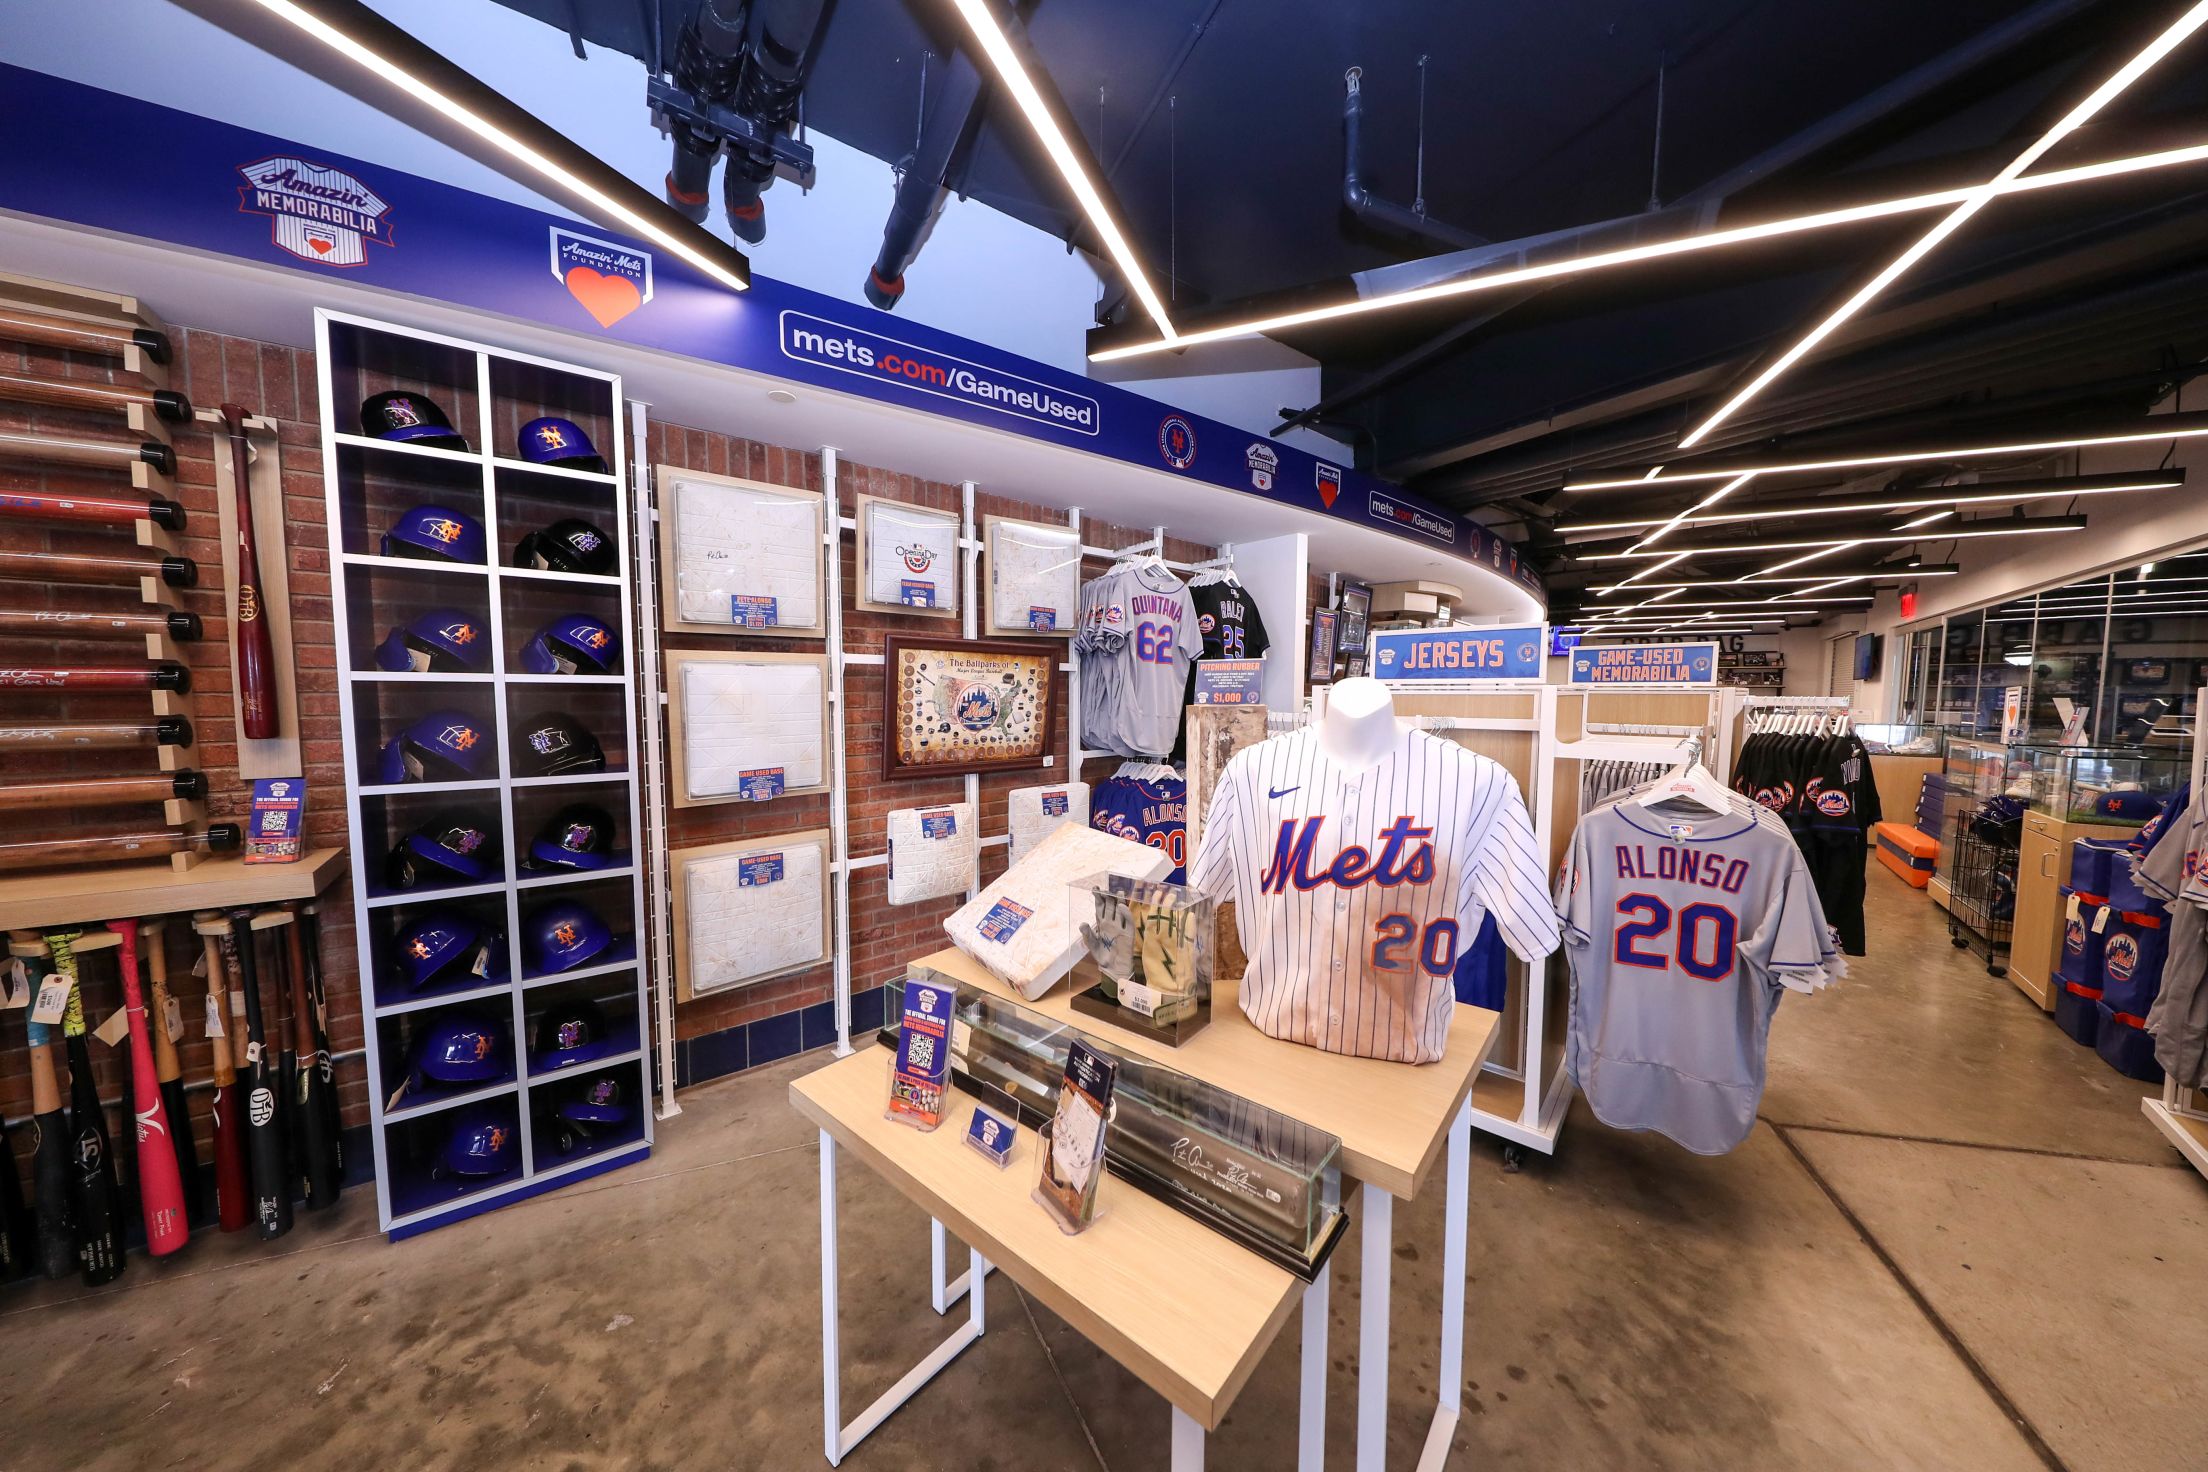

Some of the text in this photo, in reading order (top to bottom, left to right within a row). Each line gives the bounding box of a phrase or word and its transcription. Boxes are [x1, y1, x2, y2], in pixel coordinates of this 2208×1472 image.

[257, 190, 377, 235] MEMORABILIA
[562, 242, 642, 271] Amazin' Mets
[563, 252, 641, 278] FOUNDATION
[793, 328, 1092, 426] mets.com/GameUsed
[1372, 499, 1453, 538] mets.com/GameUsed
[1132, 594, 1183, 623] QUINTANA
[1136, 620, 1174, 665] 62
[1223, 625, 1245, 660] 25
[1403, 639, 1505, 669] JERSEYS
[1598, 648, 1684, 666] GAME-USED
[950, 659, 965, 668] The
[967, 659, 1000, 669] Ballparks
[1200, 661, 1260, 672] PITCHING RUBBER
[1591, 665, 1690, 682] MEMORABILIA
[1213, 692, 1241, 704] $1,000
[1261, 815, 1436, 895] Mets
[1615, 845, 1750, 895] ALONSO
[1370, 912, 1460, 978] 20
[1614, 891, 1739, 982] 20
[135, 1097, 165, 1143] Victus
